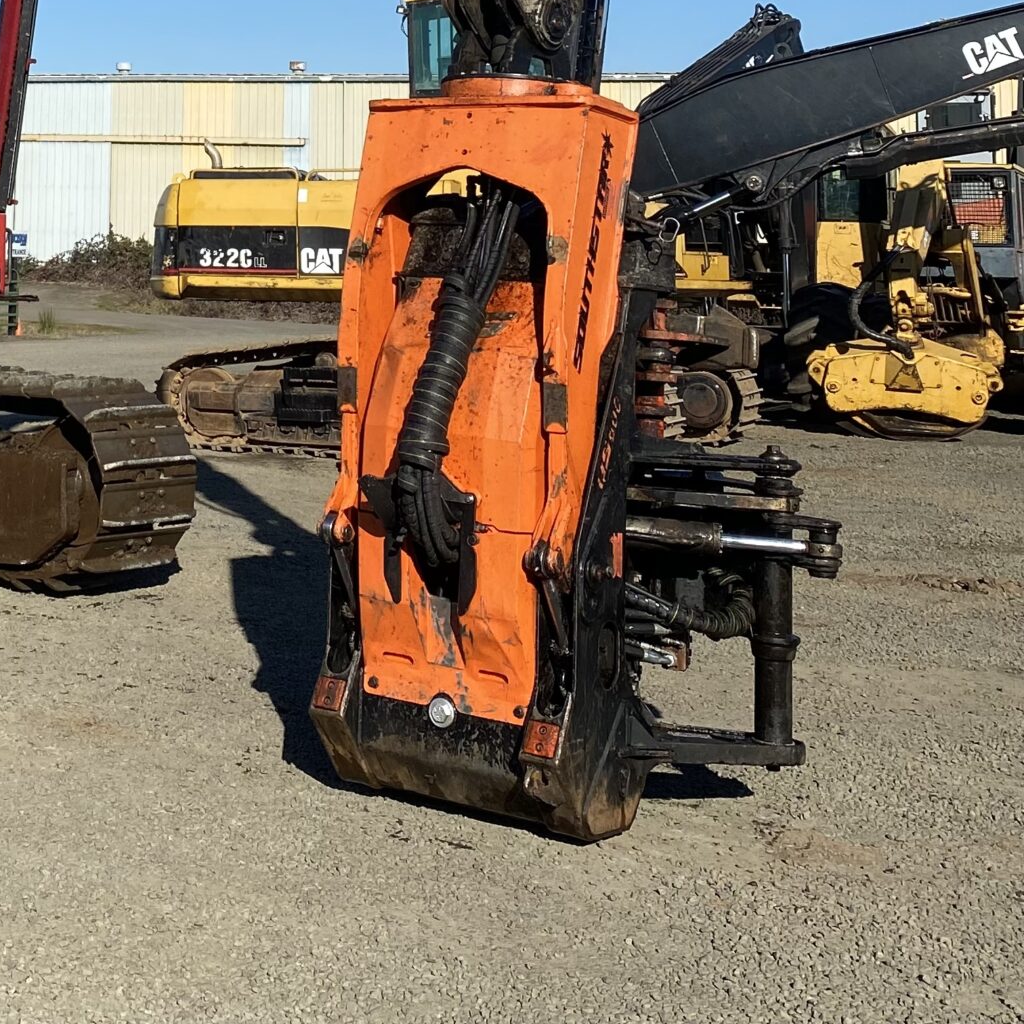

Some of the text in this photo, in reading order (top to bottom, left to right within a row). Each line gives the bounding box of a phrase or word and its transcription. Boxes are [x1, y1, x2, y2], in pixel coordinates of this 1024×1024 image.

[961, 26, 1024, 75] CAT
[199, 247, 253, 268] 322C
[300, 247, 344, 274] CAT
